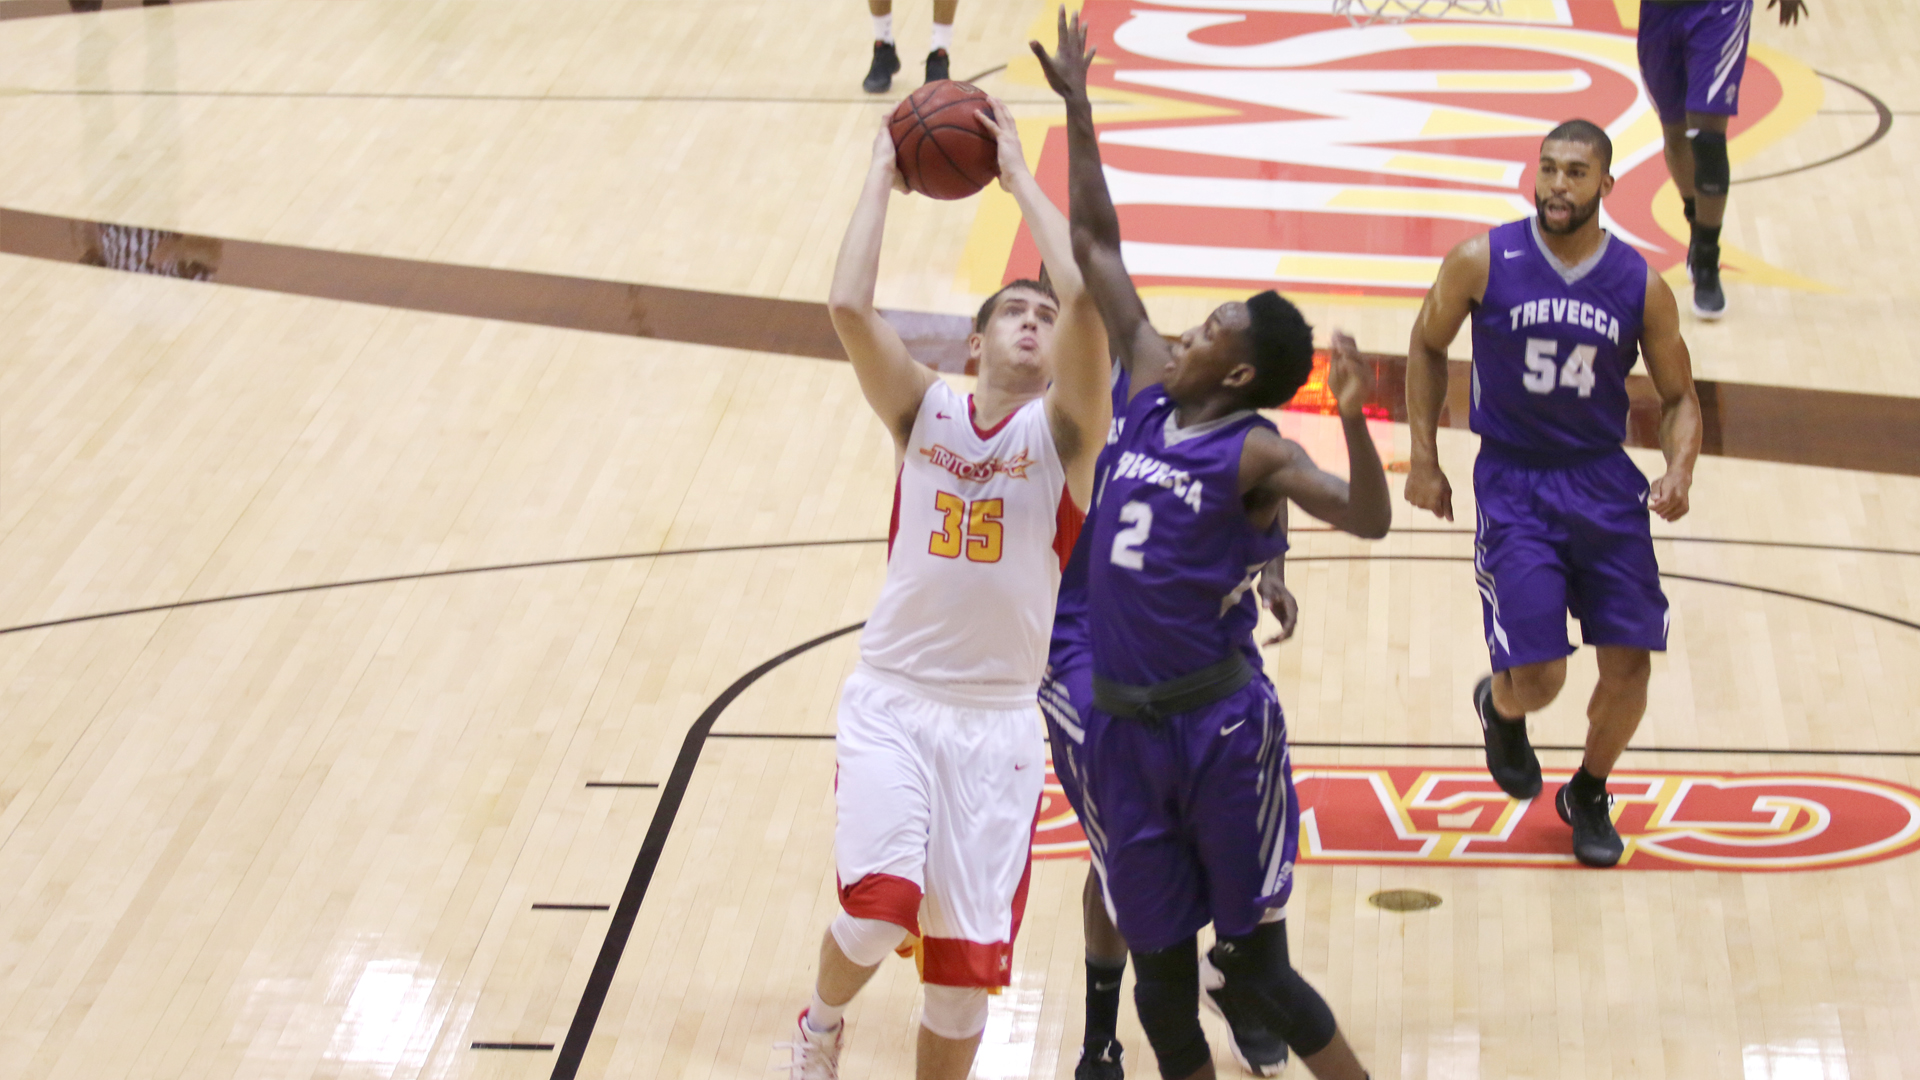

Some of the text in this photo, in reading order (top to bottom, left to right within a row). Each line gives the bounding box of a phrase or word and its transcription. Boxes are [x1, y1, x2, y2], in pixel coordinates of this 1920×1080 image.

[1510, 298, 1619, 346] TREVECCA
[1523, 338, 1597, 398] 54
[1112, 451, 1203, 514] REVECCA
[928, 490, 1004, 564] 35
[1111, 500, 1153, 571] 2
[1031, 764, 1919, 872] GLV
